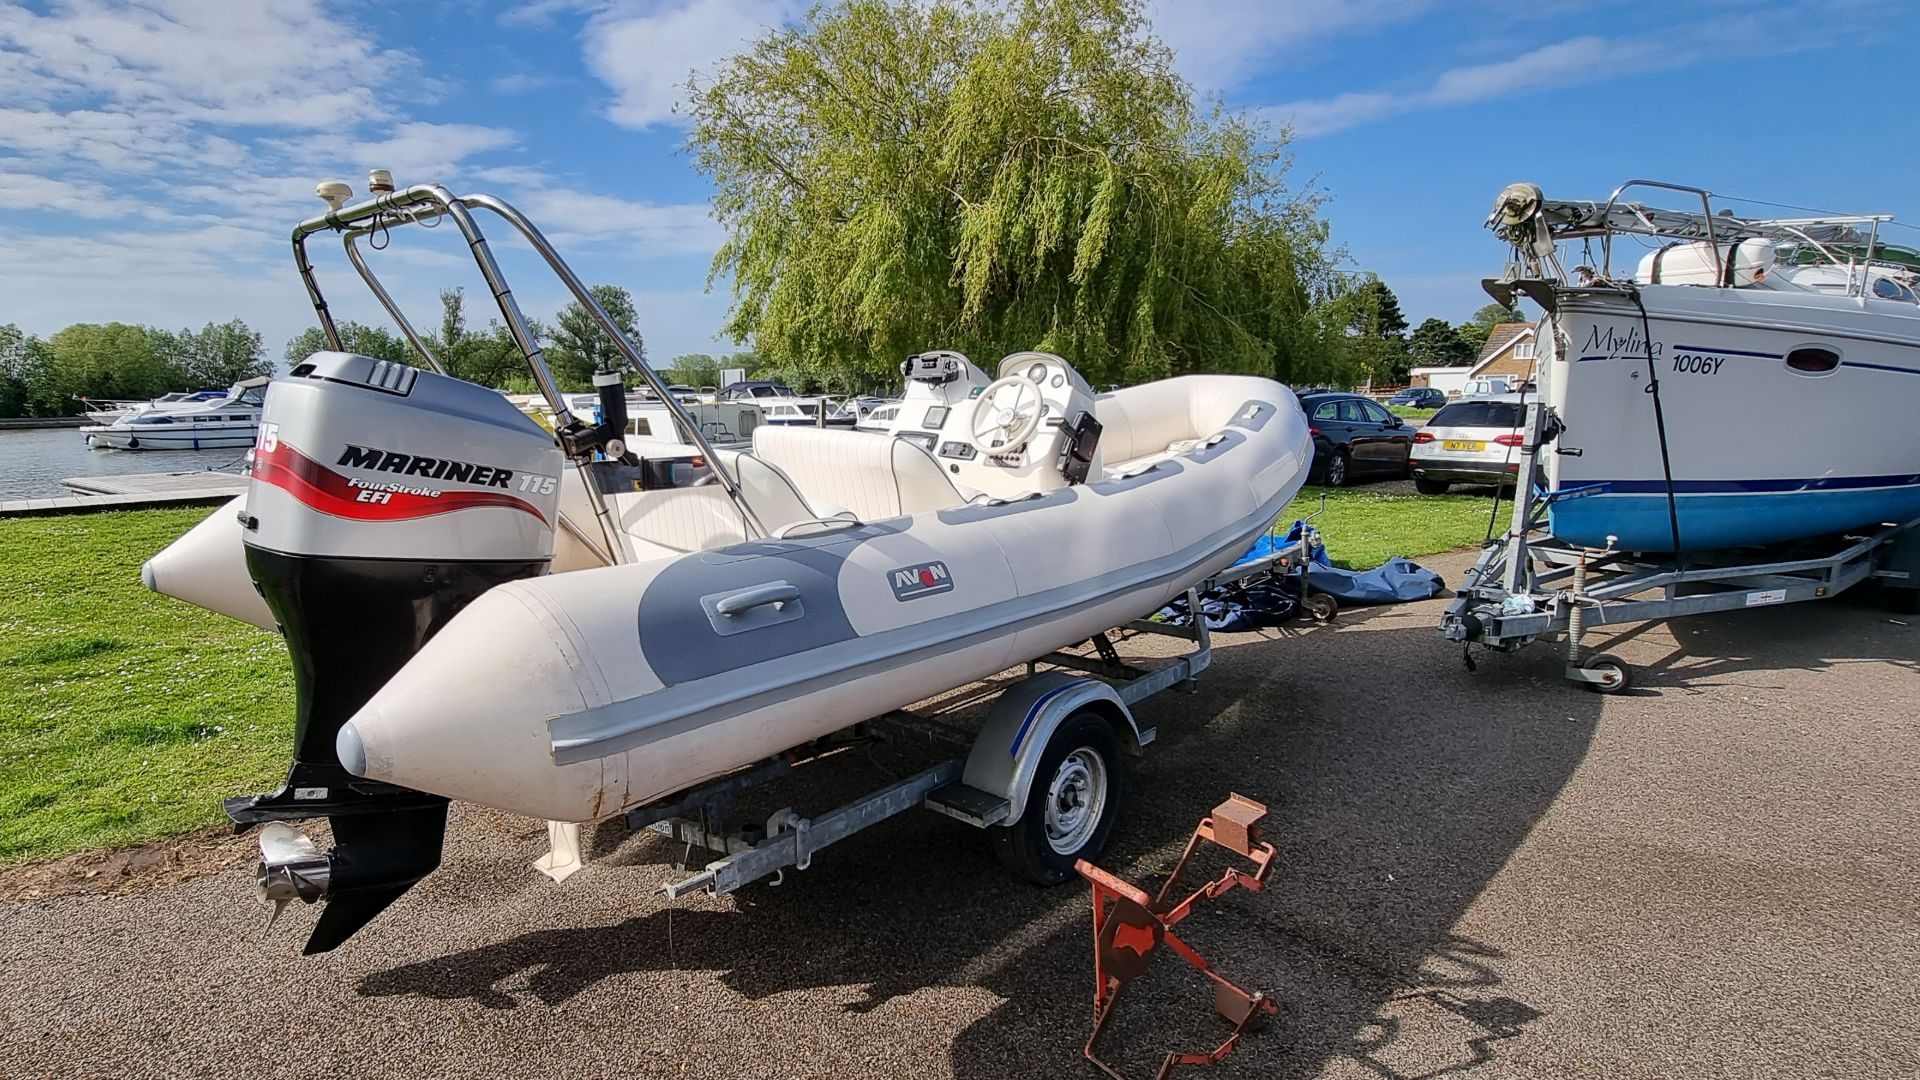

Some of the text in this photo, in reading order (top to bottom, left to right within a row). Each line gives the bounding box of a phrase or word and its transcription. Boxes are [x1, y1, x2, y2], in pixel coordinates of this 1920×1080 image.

[1581, 324, 1663, 360] Mylina
[1673, 354, 1725, 375] 1006Y
[336, 444, 558, 495] MARINER 115
[347, 477, 442, 498] FourStroke
[356, 489, 393, 505] EFI
[895, 564, 947, 588] AVON
